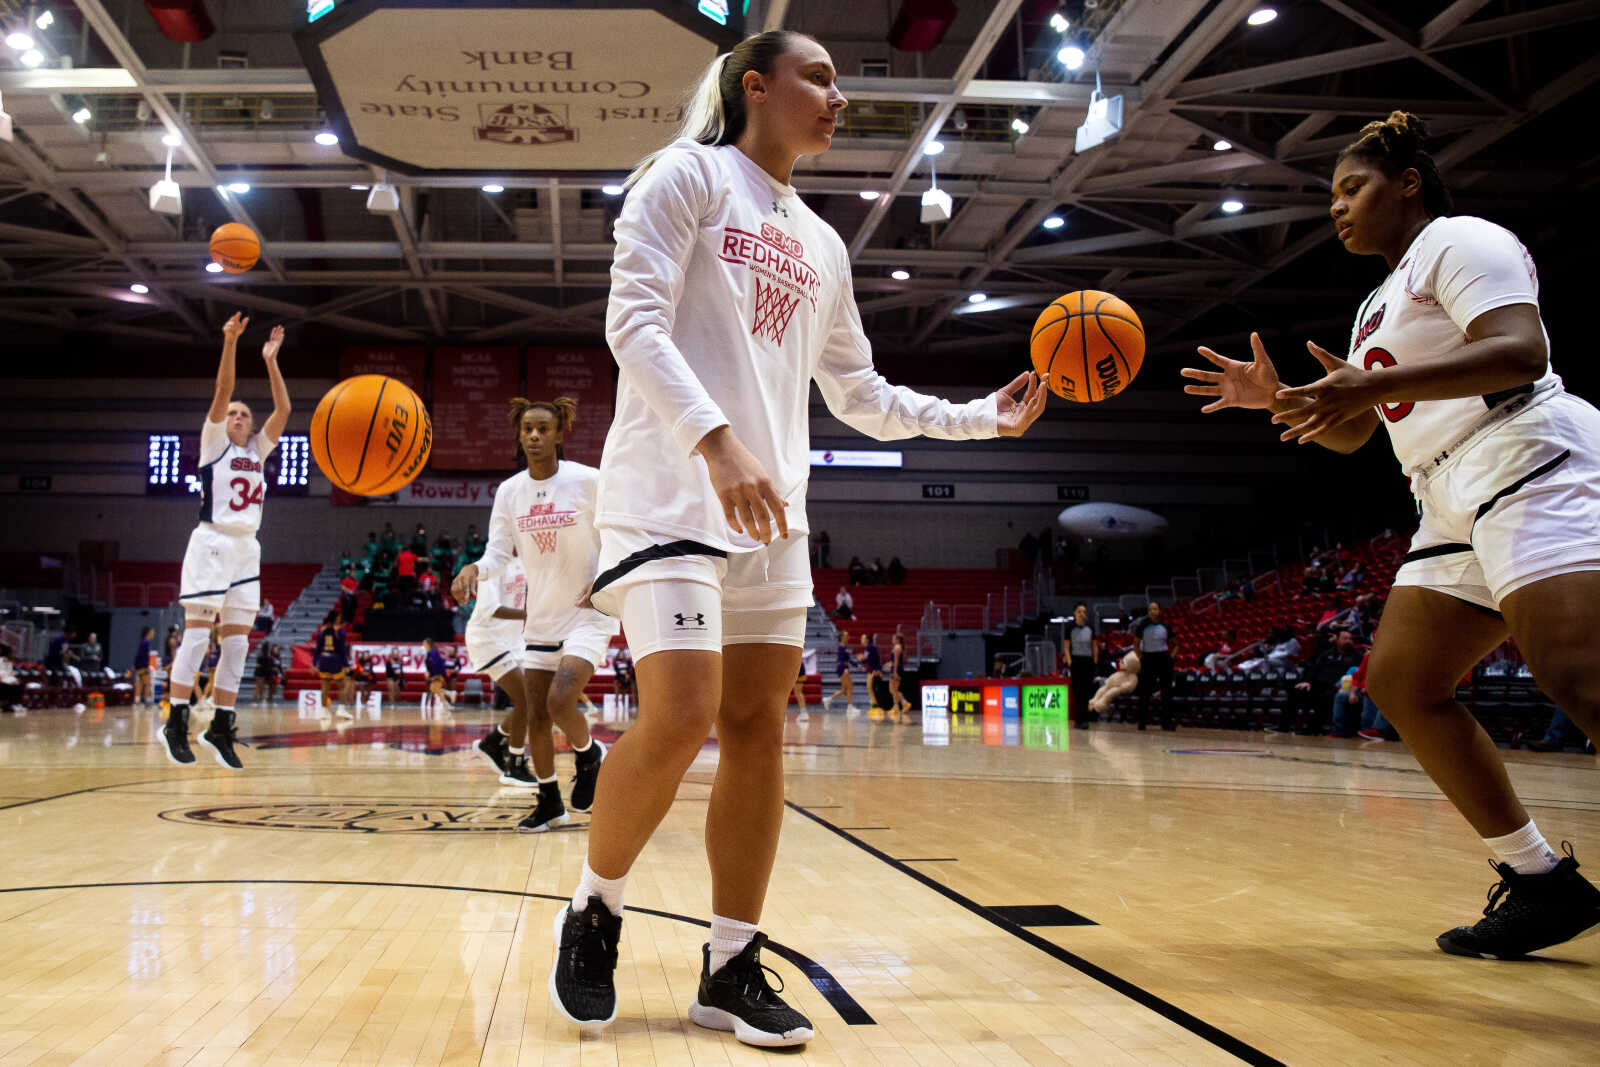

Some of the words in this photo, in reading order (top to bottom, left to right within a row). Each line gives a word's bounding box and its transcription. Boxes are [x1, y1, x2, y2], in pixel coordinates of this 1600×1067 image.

[461, 50, 574, 71] Bank
[395, 74, 651, 99] Community
[359, 101, 461, 122] State
[487, 112, 559, 129] FSCB
[595, 102, 686, 124] First
[760, 221, 804, 259] SEMO
[748, 263, 777, 282] WOMEN'S
[776, 277, 809, 300] BASKETBALL
[385, 403, 409, 453] EVO
[229, 477, 263, 512] 34
[410, 480, 481, 503] Rowdy
[926, 485, 951, 497] 101
[518, 514, 574, 529] EDHAWKS
[1028, 687, 1061, 709] cricket
